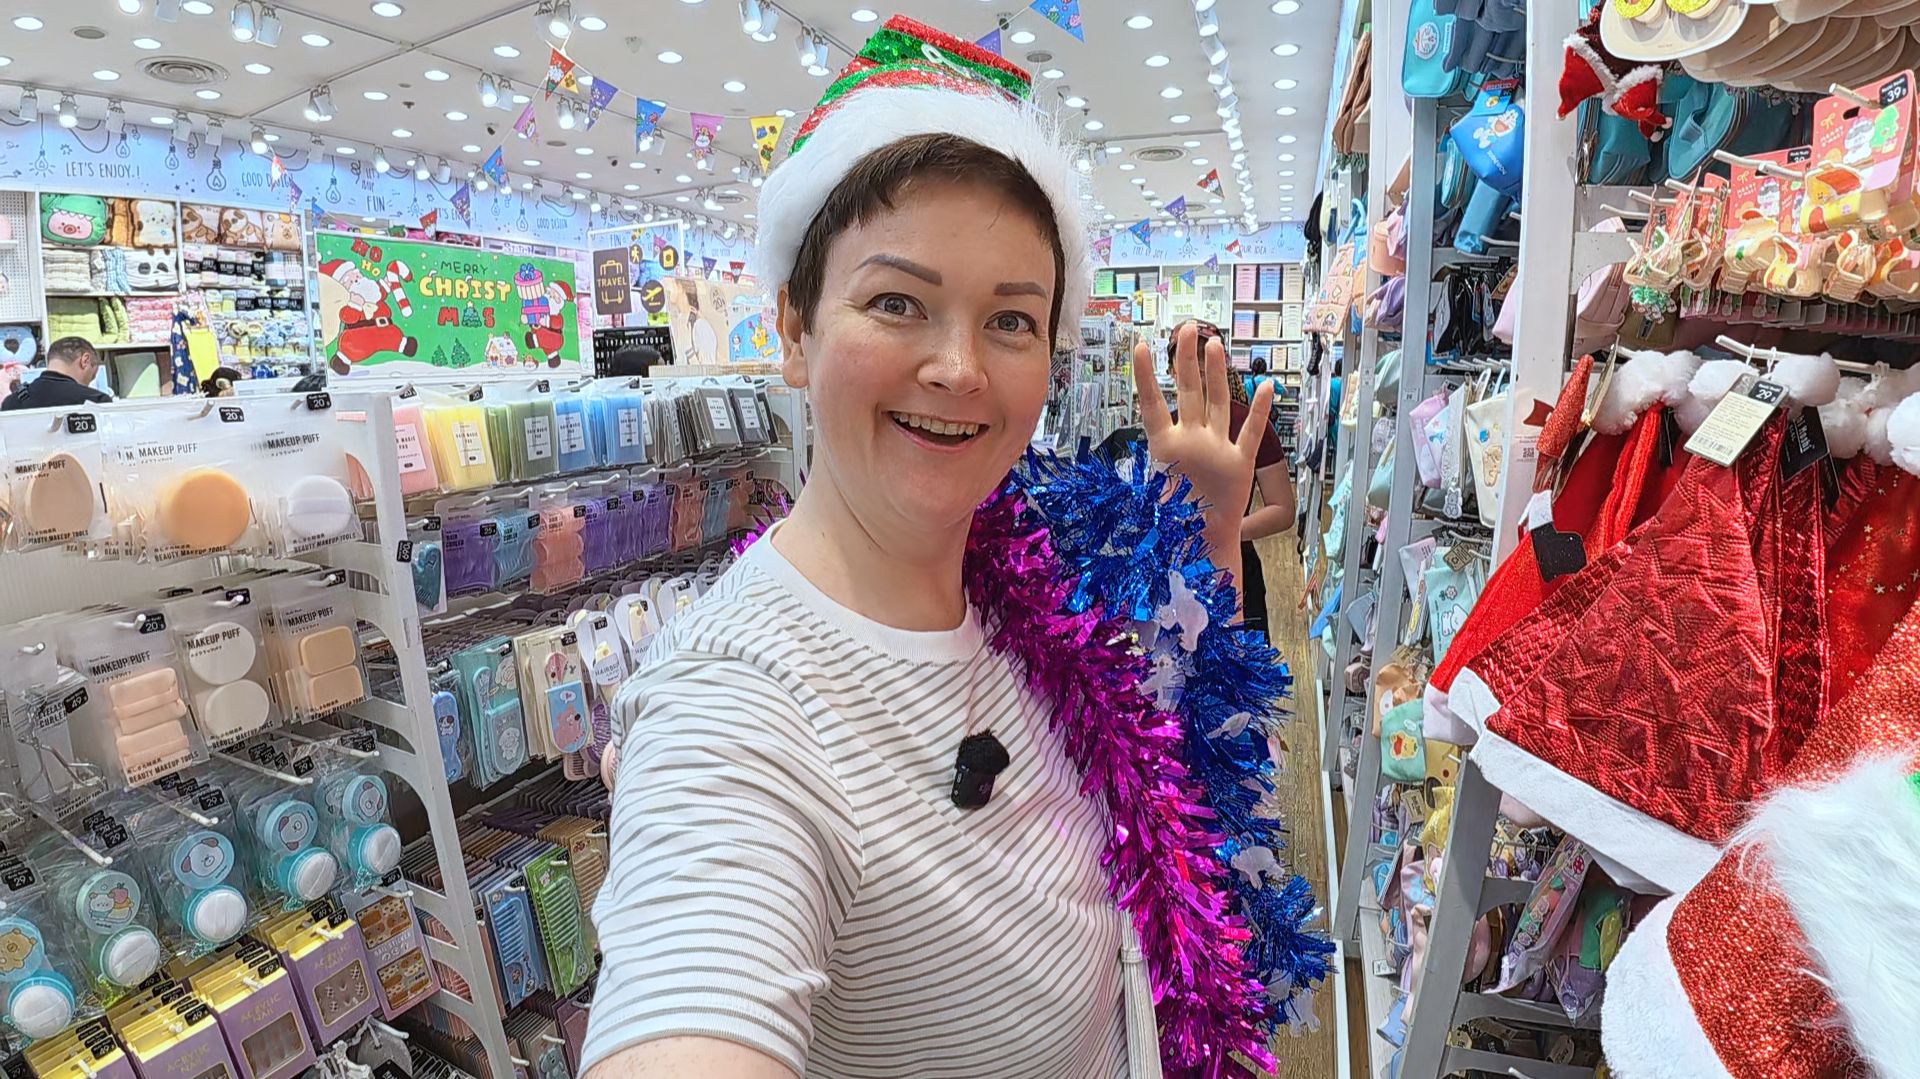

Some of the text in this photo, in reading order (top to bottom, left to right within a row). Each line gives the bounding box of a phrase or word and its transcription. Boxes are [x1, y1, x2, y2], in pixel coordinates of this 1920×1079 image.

[1887, 86, 1901, 102] 39
[66, 161, 94, 177] LET'S
[242, 172, 263, 188] GOOD
[366, 195, 385, 212] FUN
[536, 217, 549, 229] GOOD
[351, 239, 383, 263] HO
[361, 260, 381, 277] HO
[441, 261, 488, 275] MERRY
[419, 274, 512, 304] CHRIST
[597, 277, 628, 287] TRAVEL
[1755, 389, 1772, 400] 29
[313, 399, 325, 408] 20
[225, 412, 238, 420] 20
[74, 421, 89, 431] 20
[267, 433, 320, 450] MAKEUP PUFF
[138, 445, 175, 458] MAKEUP
[177, 442, 198, 454] PUFF
[15, 460, 66, 474] MAKEUP PUFF
[49, 533, 71, 542] MAKEUP
[72, 530, 88, 539] TOOLS
[294, 543, 316, 554] BEAUTY
[317, 537, 339, 548] MAKEUP
[340, 532, 356, 542] TOOLS
[154, 545, 227, 563] BEAUTY MAKEUP TOOLS
[287, 606, 334, 627] MAKEUP PUFF
[145, 621, 158, 632] 20
[187, 627, 240, 650] MAKEUP PUFF
[92, 658, 128, 676] MAKEUP
[129, 650, 151, 664] PUFF
[71, 696, 82, 708] 49
[38, 701, 66, 719] EYELAS
[235, 728, 257, 740] MAKEUP
[128, 770, 153, 784] BEAUTY
[154, 759, 180, 774] MAKEUP
[180, 750, 199, 763] TOOLS
[206, 797, 217, 807] 29
[109, 833, 121, 844] 29
[14, 876, 27, 887] 29
[333, 914, 343, 924] 49
[264, 964, 274, 974] 49
[192, 1010, 203, 1021] 49
[99, 1045, 110, 1056] 49
